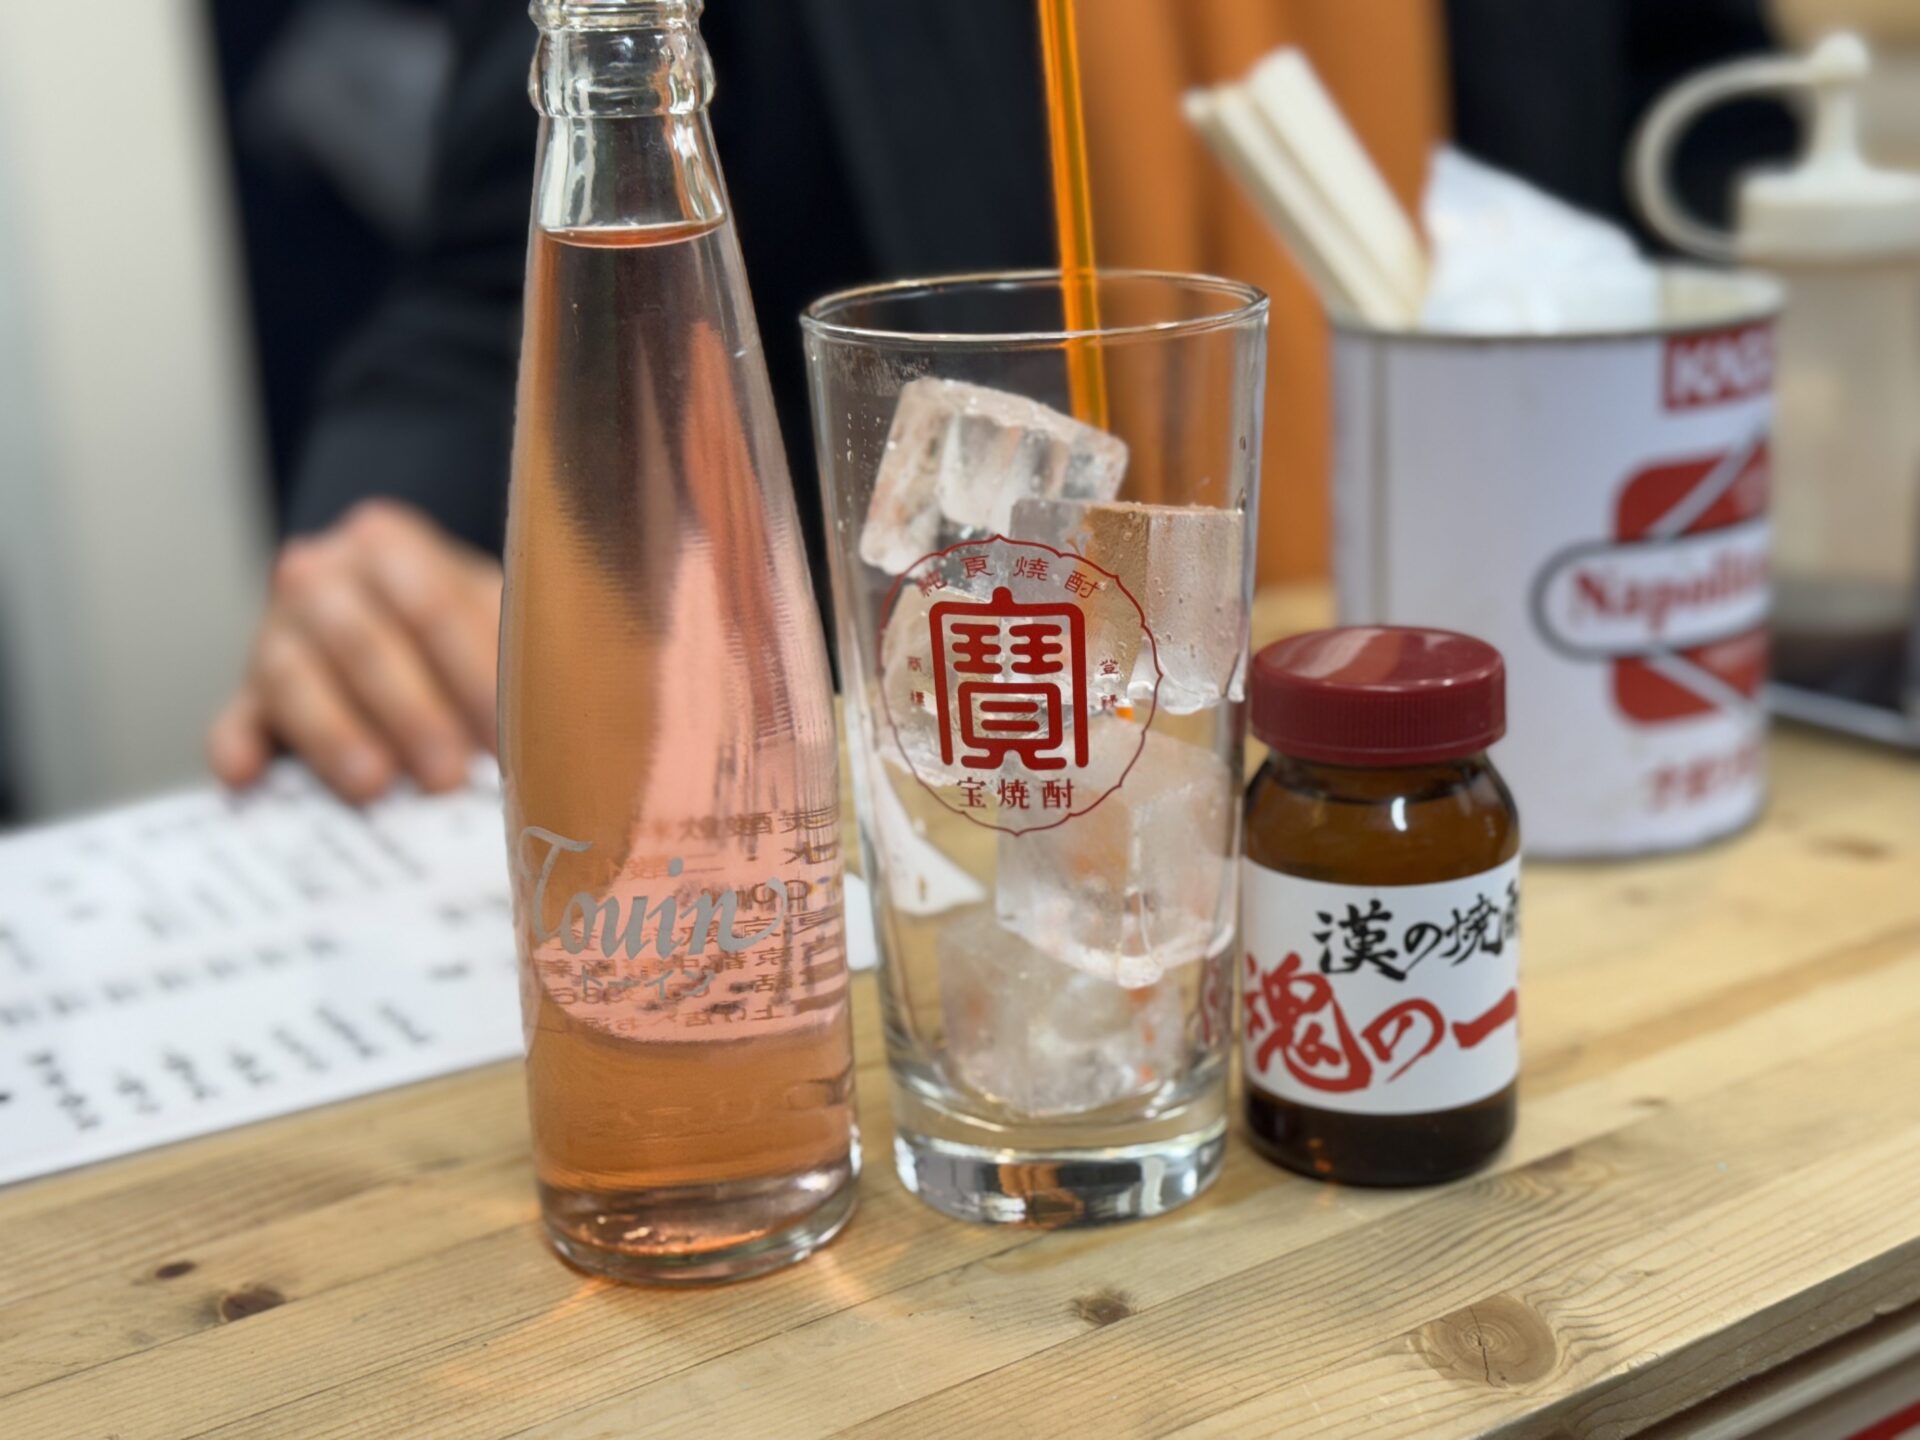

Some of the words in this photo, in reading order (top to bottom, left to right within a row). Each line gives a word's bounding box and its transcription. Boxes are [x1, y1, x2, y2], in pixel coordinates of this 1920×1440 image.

[957, 777, 1074, 809] 宝焼酎
[581, 964, 716, 1001] トーイン
